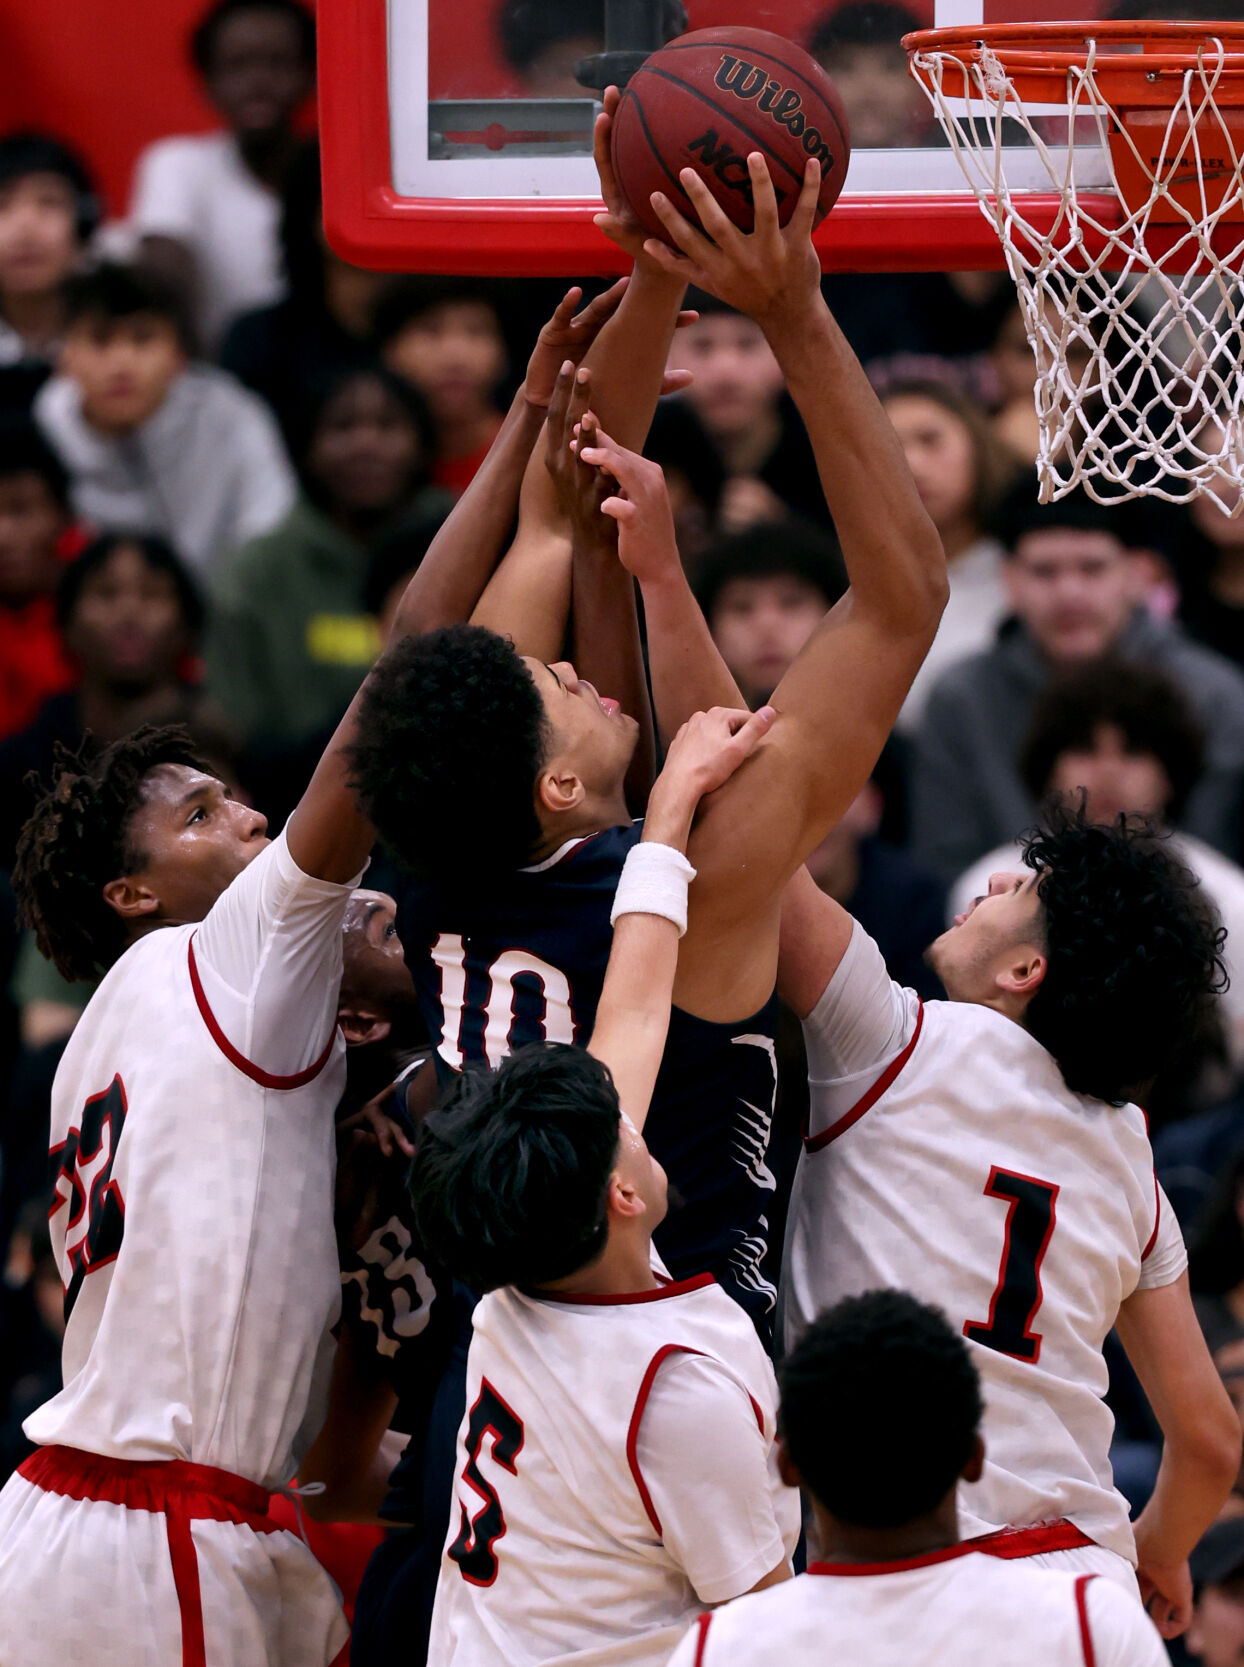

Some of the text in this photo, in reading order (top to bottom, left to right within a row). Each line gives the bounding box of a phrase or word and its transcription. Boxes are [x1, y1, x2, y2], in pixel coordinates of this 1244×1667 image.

[714, 54, 834, 183] Wilson
[430, 933, 579, 1072] 10
[963, 1165, 1060, 1365] 1
[447, 1375, 525, 1588] 5
